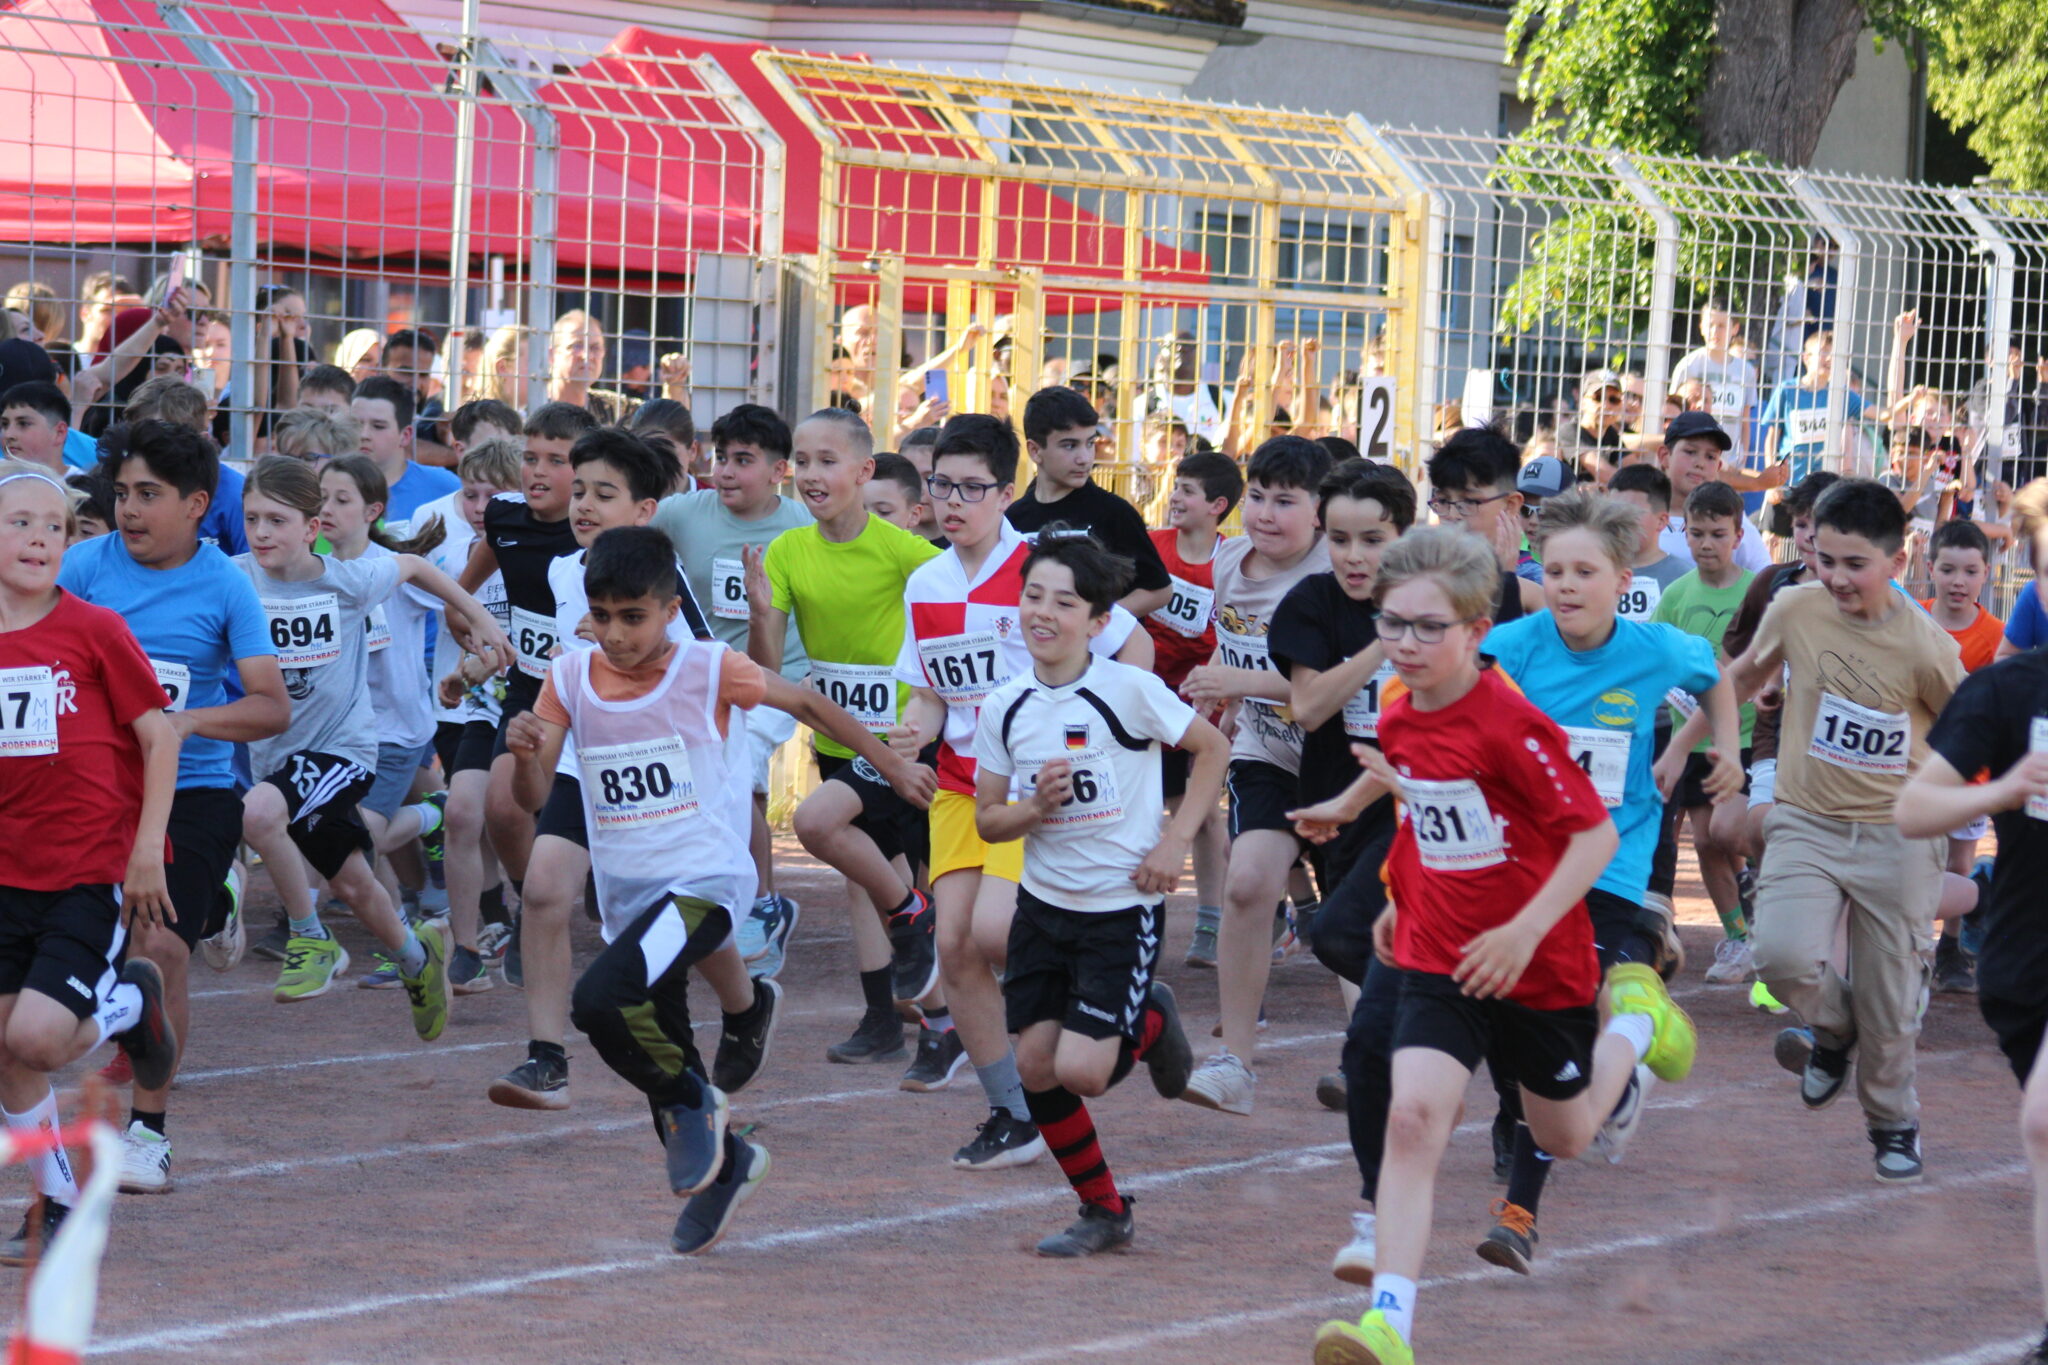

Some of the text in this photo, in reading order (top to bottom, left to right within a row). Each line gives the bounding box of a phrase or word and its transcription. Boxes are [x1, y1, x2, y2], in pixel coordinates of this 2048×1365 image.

[1368, 386, 1390, 457] 2
[725, 576, 748, 602] 6
[280, 604, 295, 612] SIND
[296, 602, 308, 611] WIR
[308, 599, 334, 609] STÄRKER
[1617, 590, 1648, 614] 89
[270, 613, 335, 648] 694
[520, 628, 560, 661] 62
[920, 635, 995, 652] GEMEINSAM SIND WIR STÄRKER
[17, 673, 47, 682] STÄRKER
[158, 668, 187, 677] STÄRKER
[928, 650, 995, 688] 1617
[816, 678, 889, 712] 1040
[1598, 736, 1626, 745] STÄRKER
[1824, 714, 1905, 757] 1502
[618, 751, 634, 759] SIND
[635, 749, 649, 757] WIR
[649, 743, 680, 754] STÄRKER
[1076, 750, 1105, 762] STÄRKER
[600, 762, 672, 805] 830
[610, 801, 699, 823] HANAU-RODENBACH
[1078, 1000, 1119, 1024] hummel
